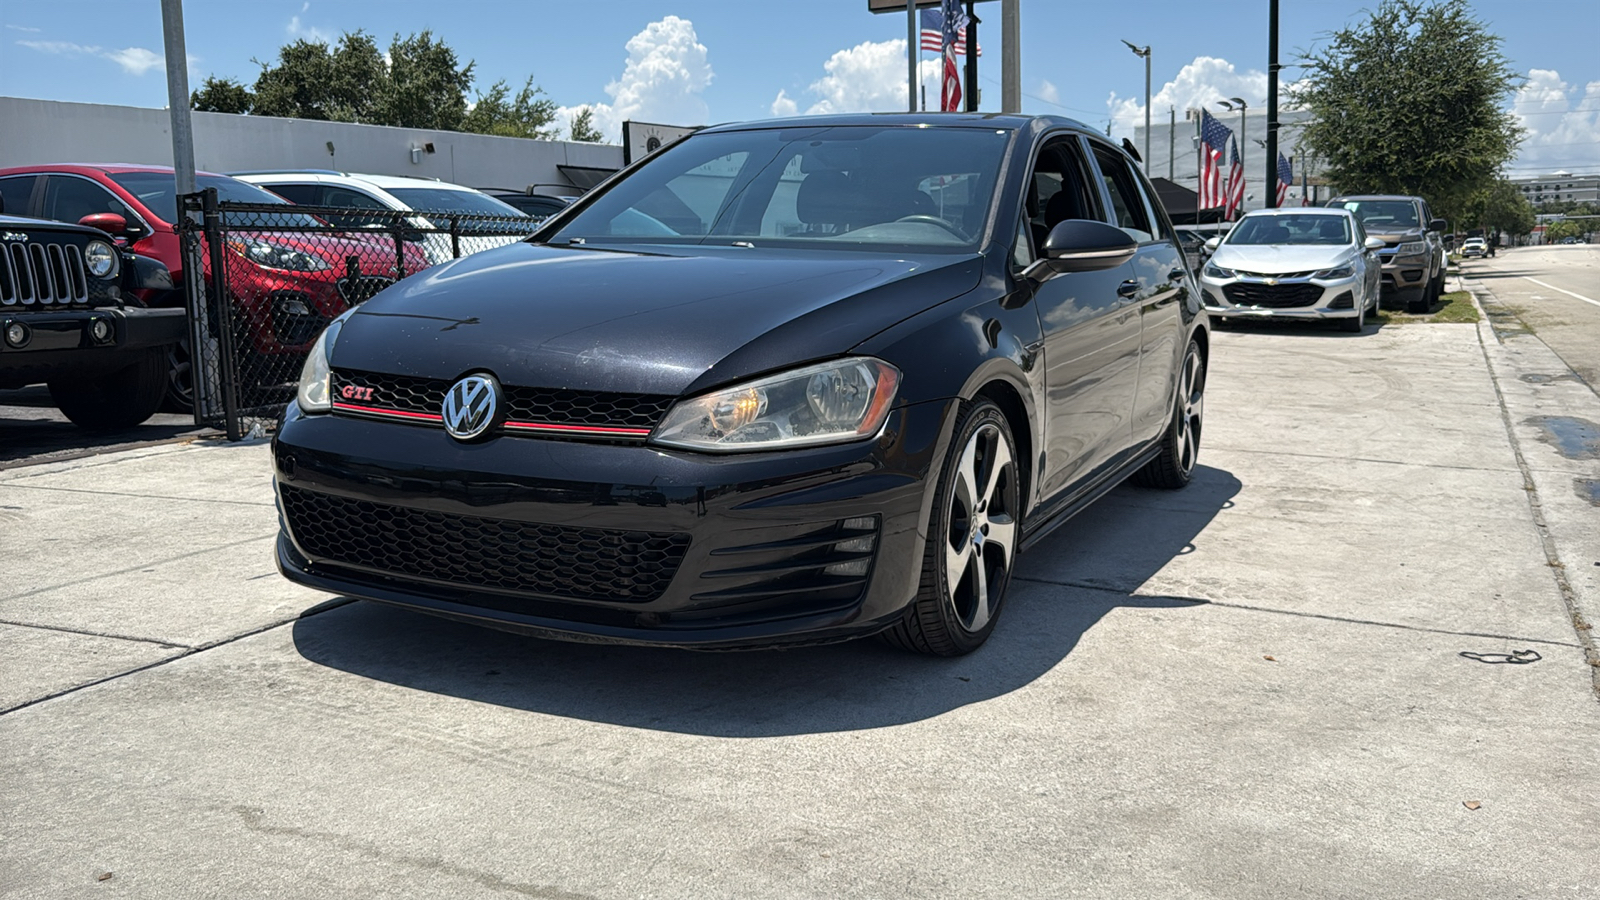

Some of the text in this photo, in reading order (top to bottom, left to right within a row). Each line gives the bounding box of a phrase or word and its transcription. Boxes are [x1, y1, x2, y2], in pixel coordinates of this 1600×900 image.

[3, 231, 29, 242] Jeep
[342, 385, 374, 401] GTI
[443, 377, 496, 438] VW
